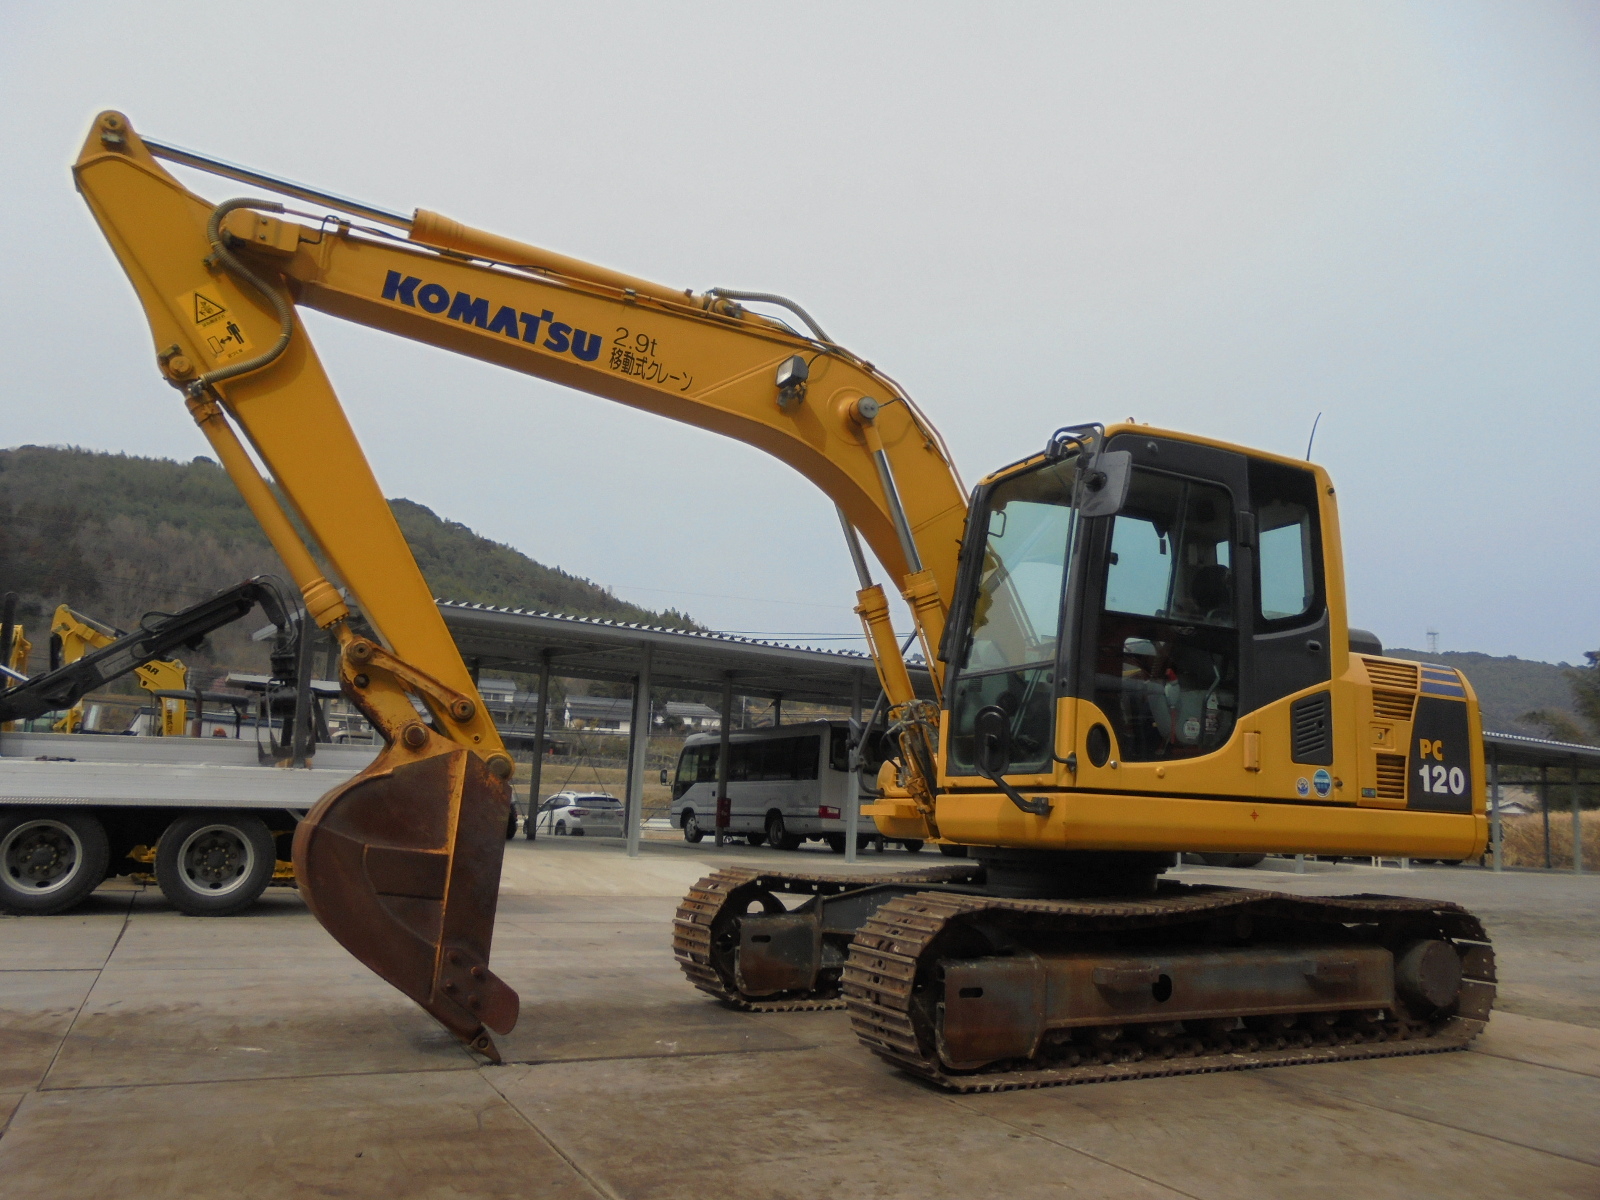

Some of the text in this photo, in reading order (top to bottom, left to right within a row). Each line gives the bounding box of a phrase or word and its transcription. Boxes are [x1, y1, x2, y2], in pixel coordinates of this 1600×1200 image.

[381, 269, 603, 362] KOMATSU
[613, 326, 658, 357] 2.9t
[608, 346, 693, 392] 移動式クレーン
[1419, 738, 1443, 761] PC
[1418, 764, 1465, 795] 120
